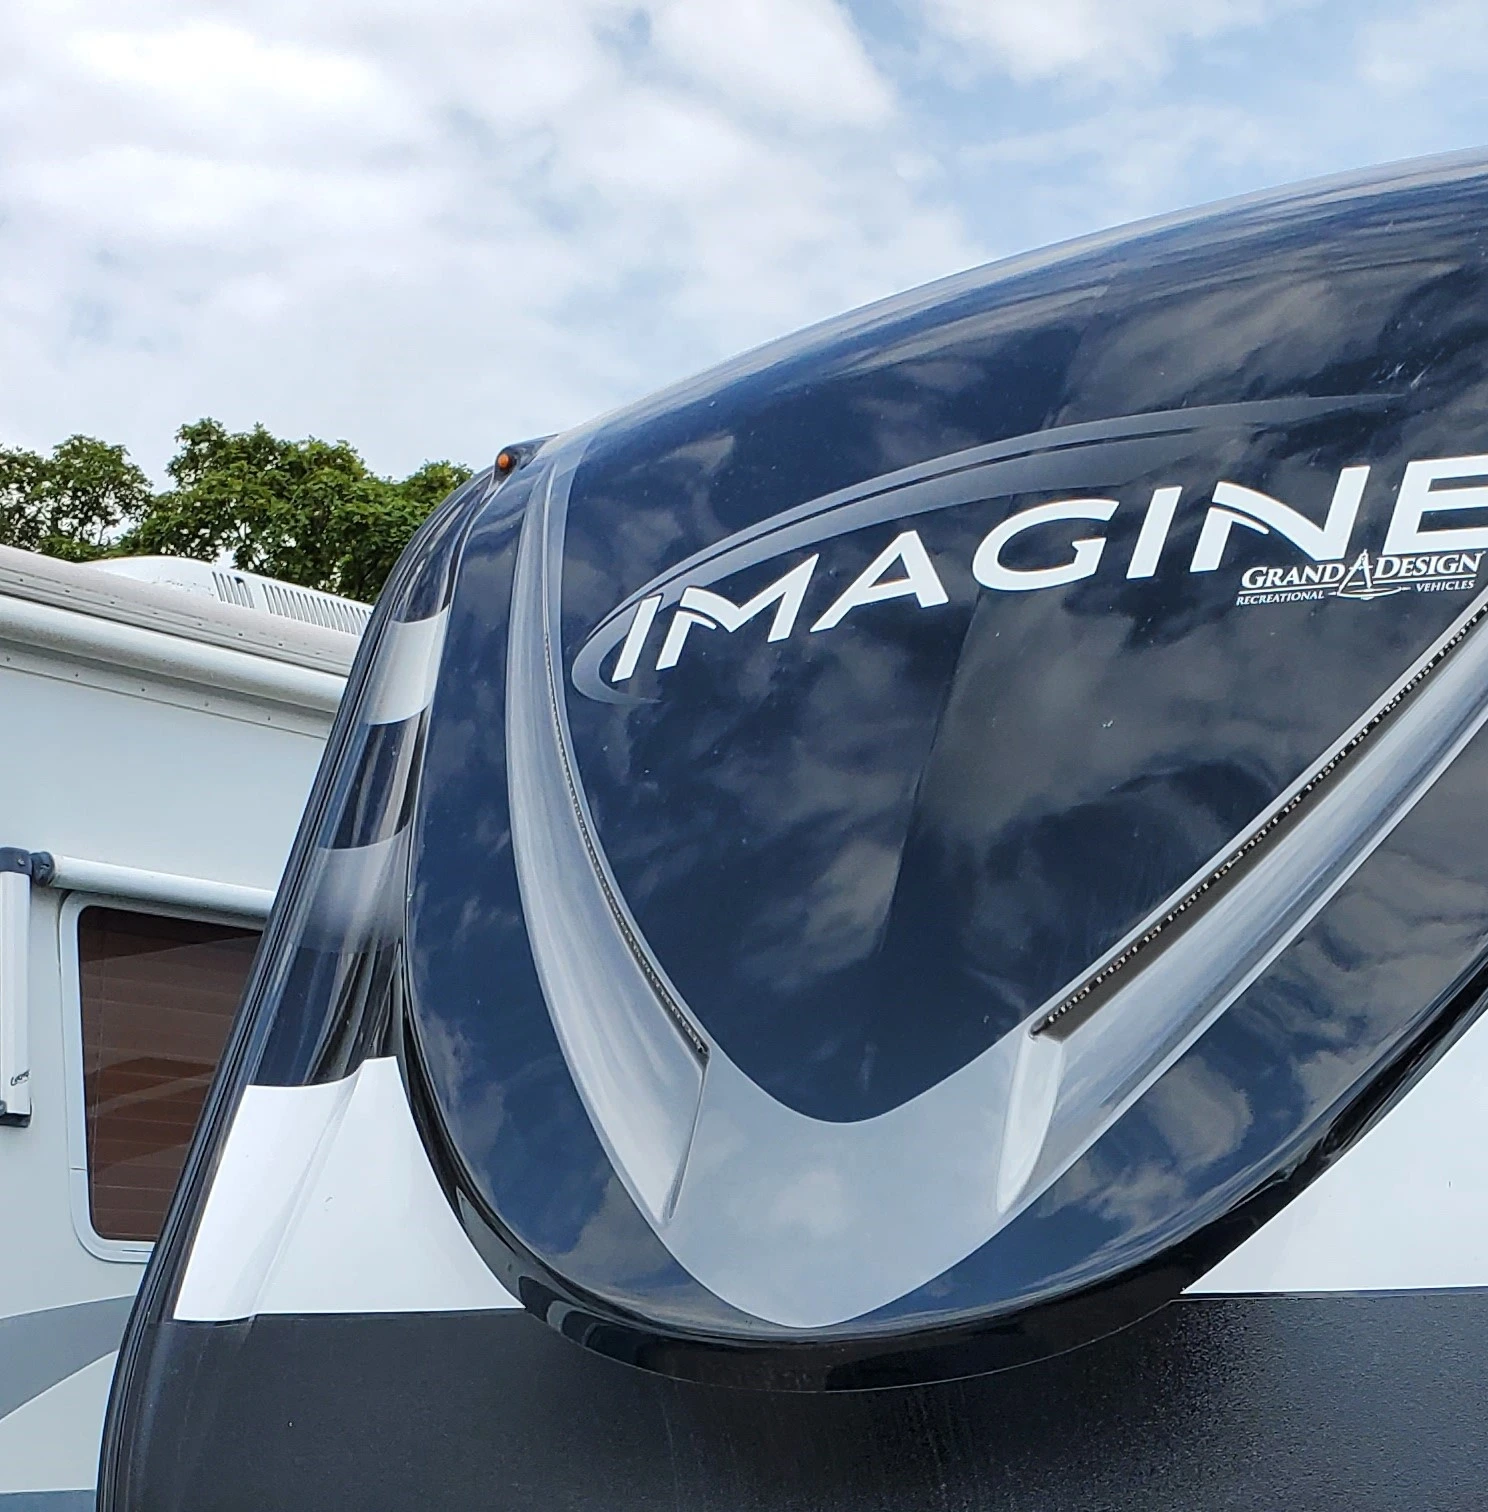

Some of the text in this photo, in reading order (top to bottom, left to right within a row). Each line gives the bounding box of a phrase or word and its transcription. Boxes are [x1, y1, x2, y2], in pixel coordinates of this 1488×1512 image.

[1241, 551, 1483, 589] GRAND DESIGN
[1236, 579, 1475, 606] RECREATIONAL VEHICLES
